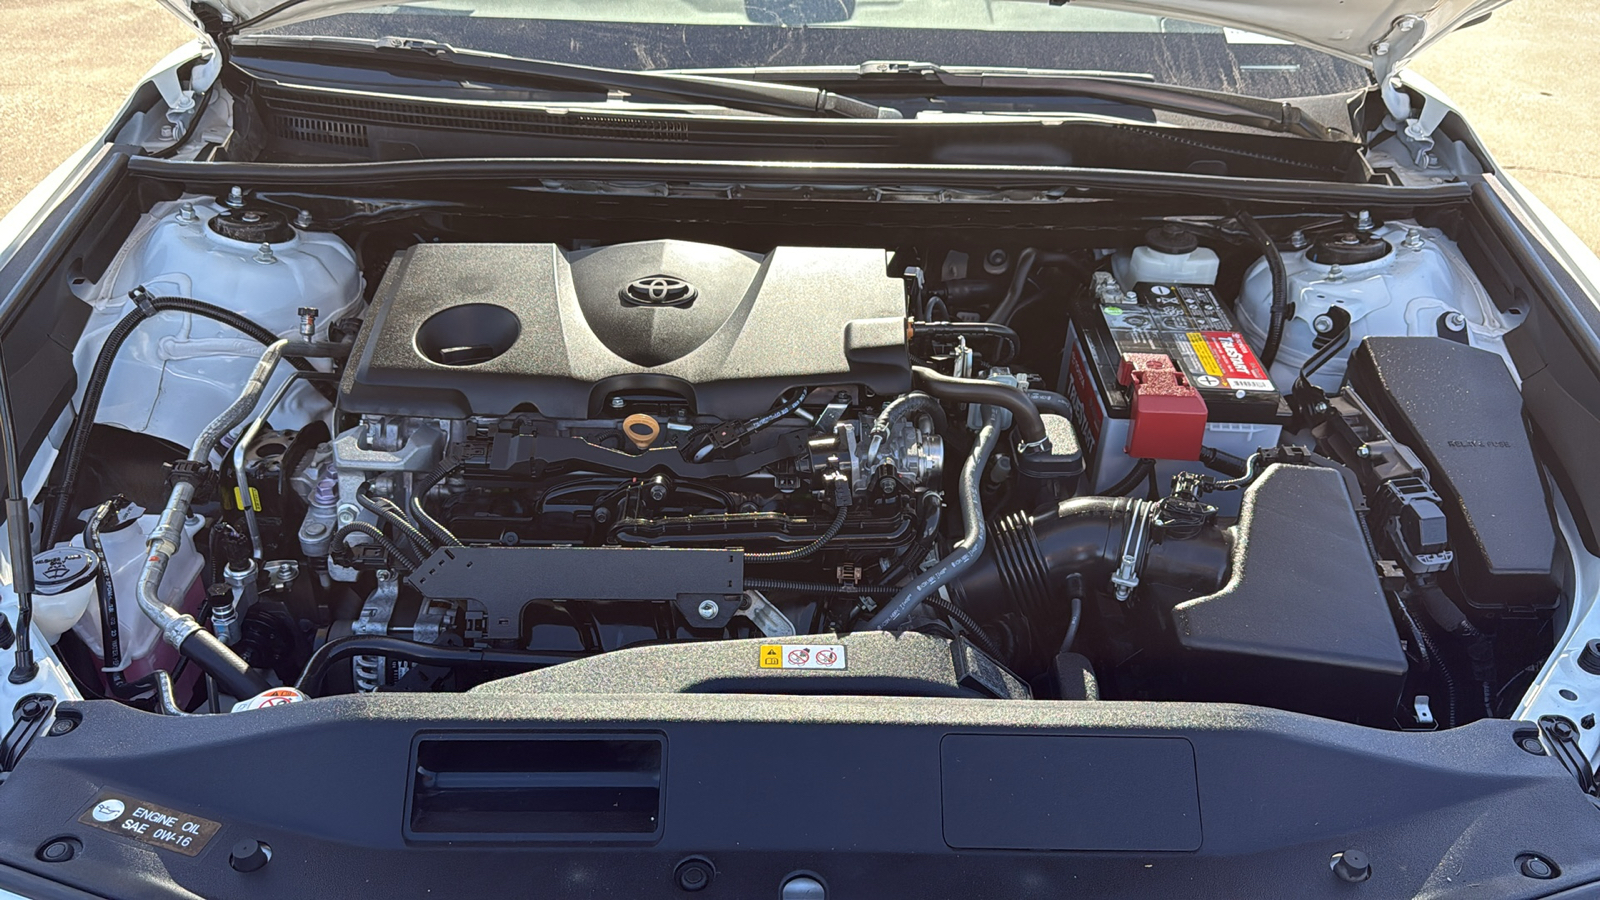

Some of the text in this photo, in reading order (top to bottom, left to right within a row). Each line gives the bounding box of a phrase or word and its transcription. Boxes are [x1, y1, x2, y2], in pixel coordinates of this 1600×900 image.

[121, 819, 193, 847] SAE 0W-16
[132, 807, 200, 835] ENGINE OIL
